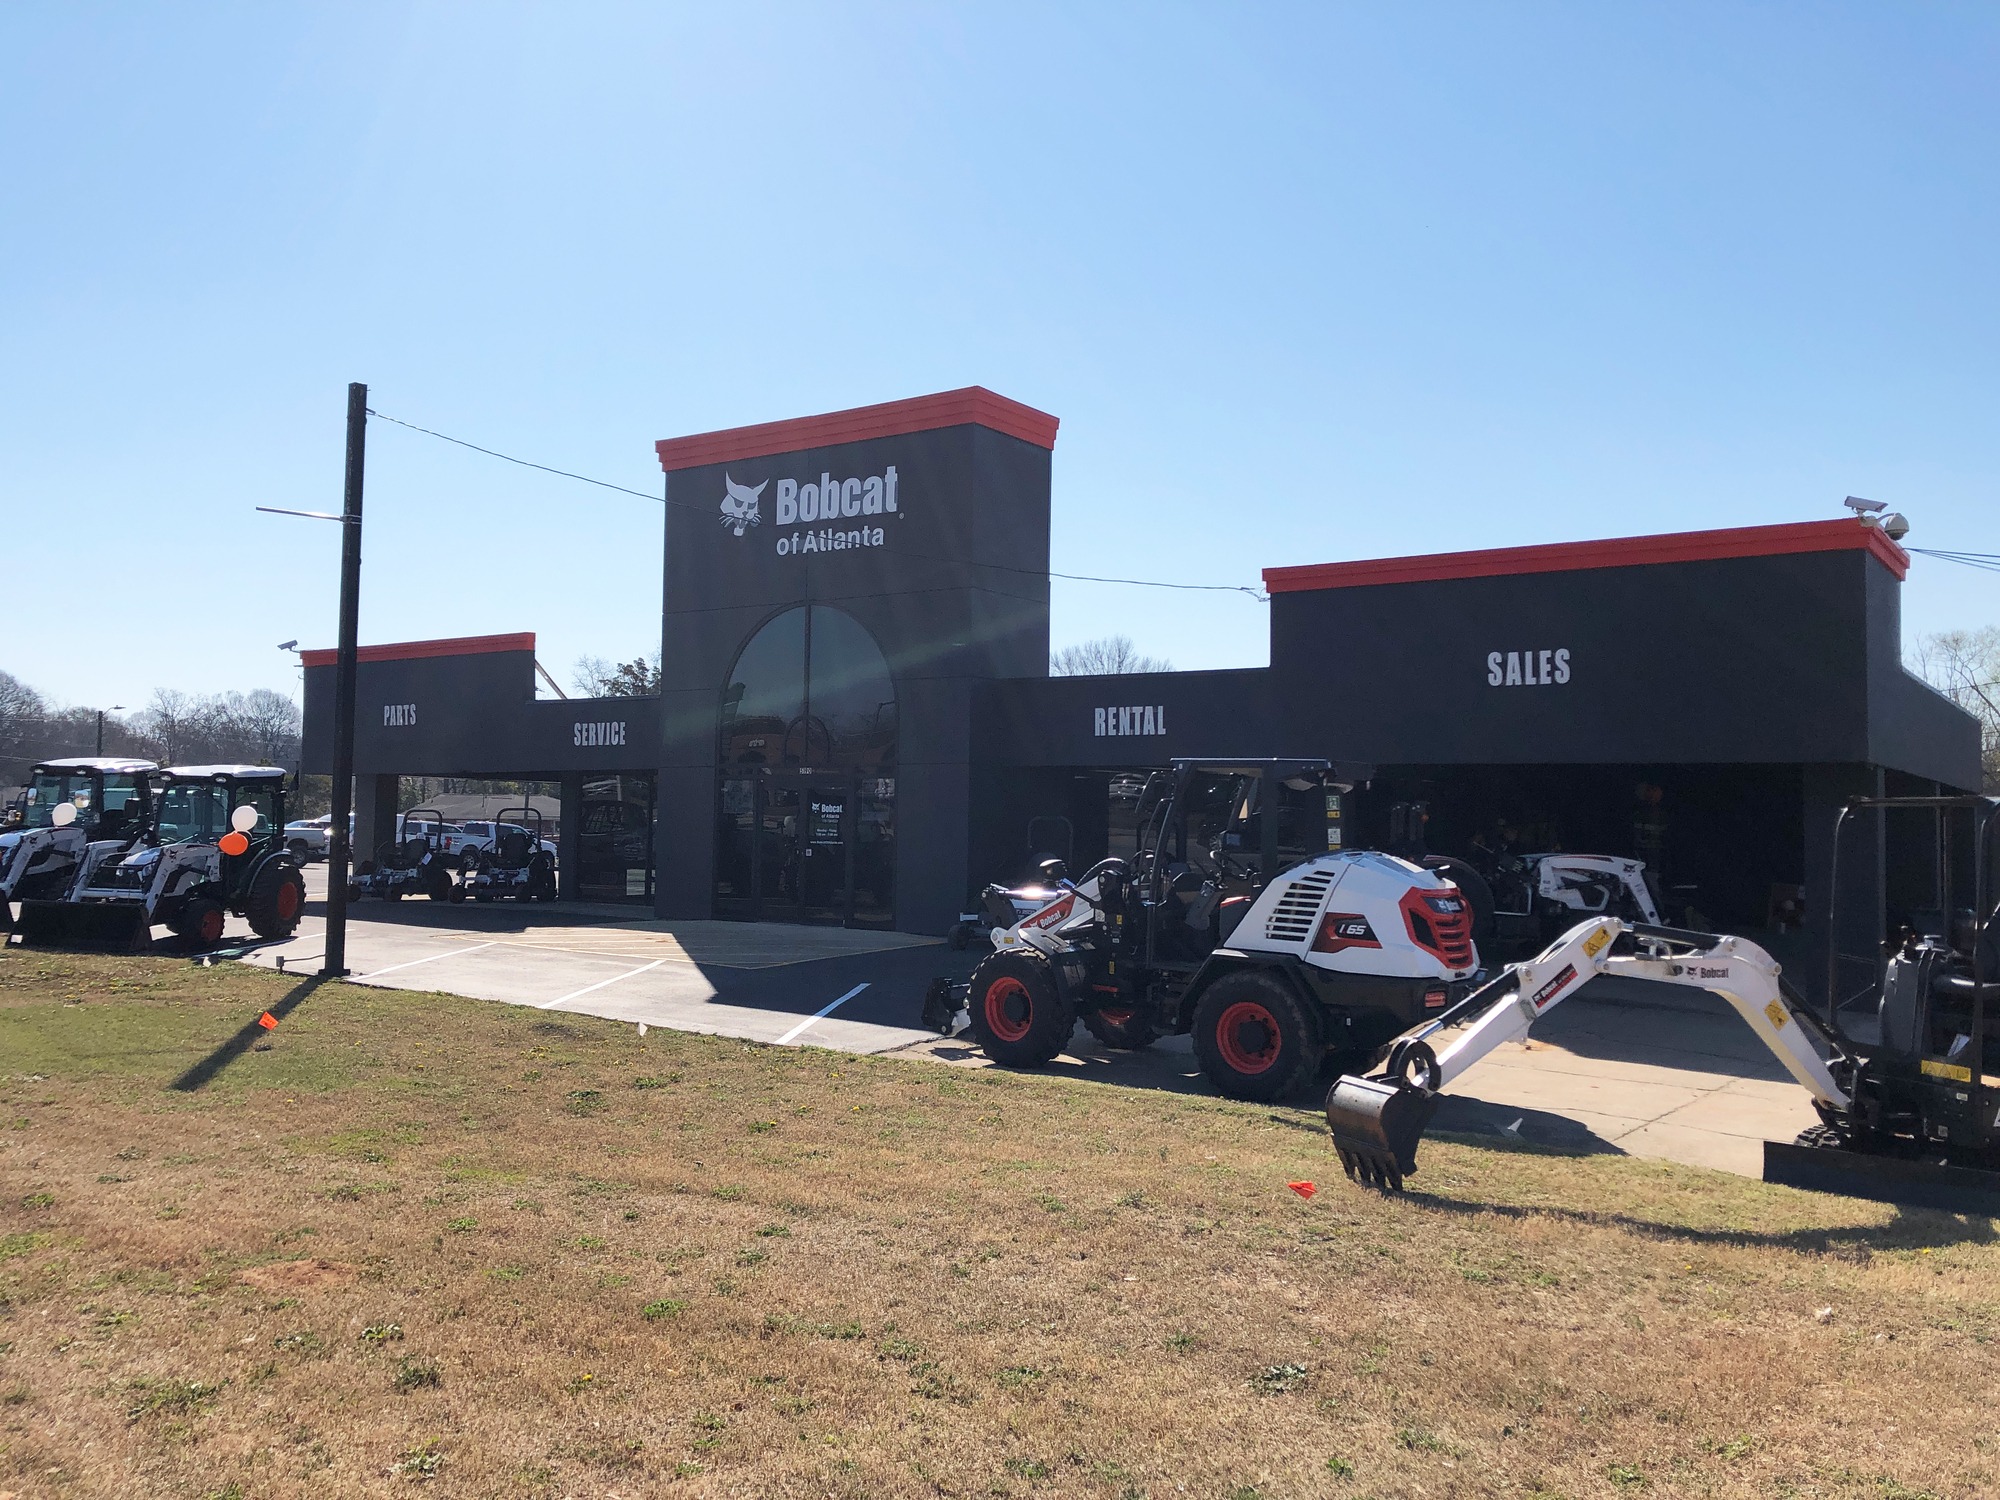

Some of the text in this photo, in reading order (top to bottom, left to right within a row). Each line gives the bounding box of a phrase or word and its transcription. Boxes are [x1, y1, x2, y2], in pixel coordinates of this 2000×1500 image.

[776, 465, 898, 526] Bobcat
[776, 525, 885, 555] of Atlanta
[1487, 648, 1571, 686] SALES
[383, 703, 417, 726] PARTS
[1094, 705, 1166, 736] RENTAL
[573, 721, 626, 746] SERVICE
[821, 803, 843, 813] Bobcat
[1039, 909, 1062, 928] Bobcat
[1700, 966, 1729, 979] Bobcat
